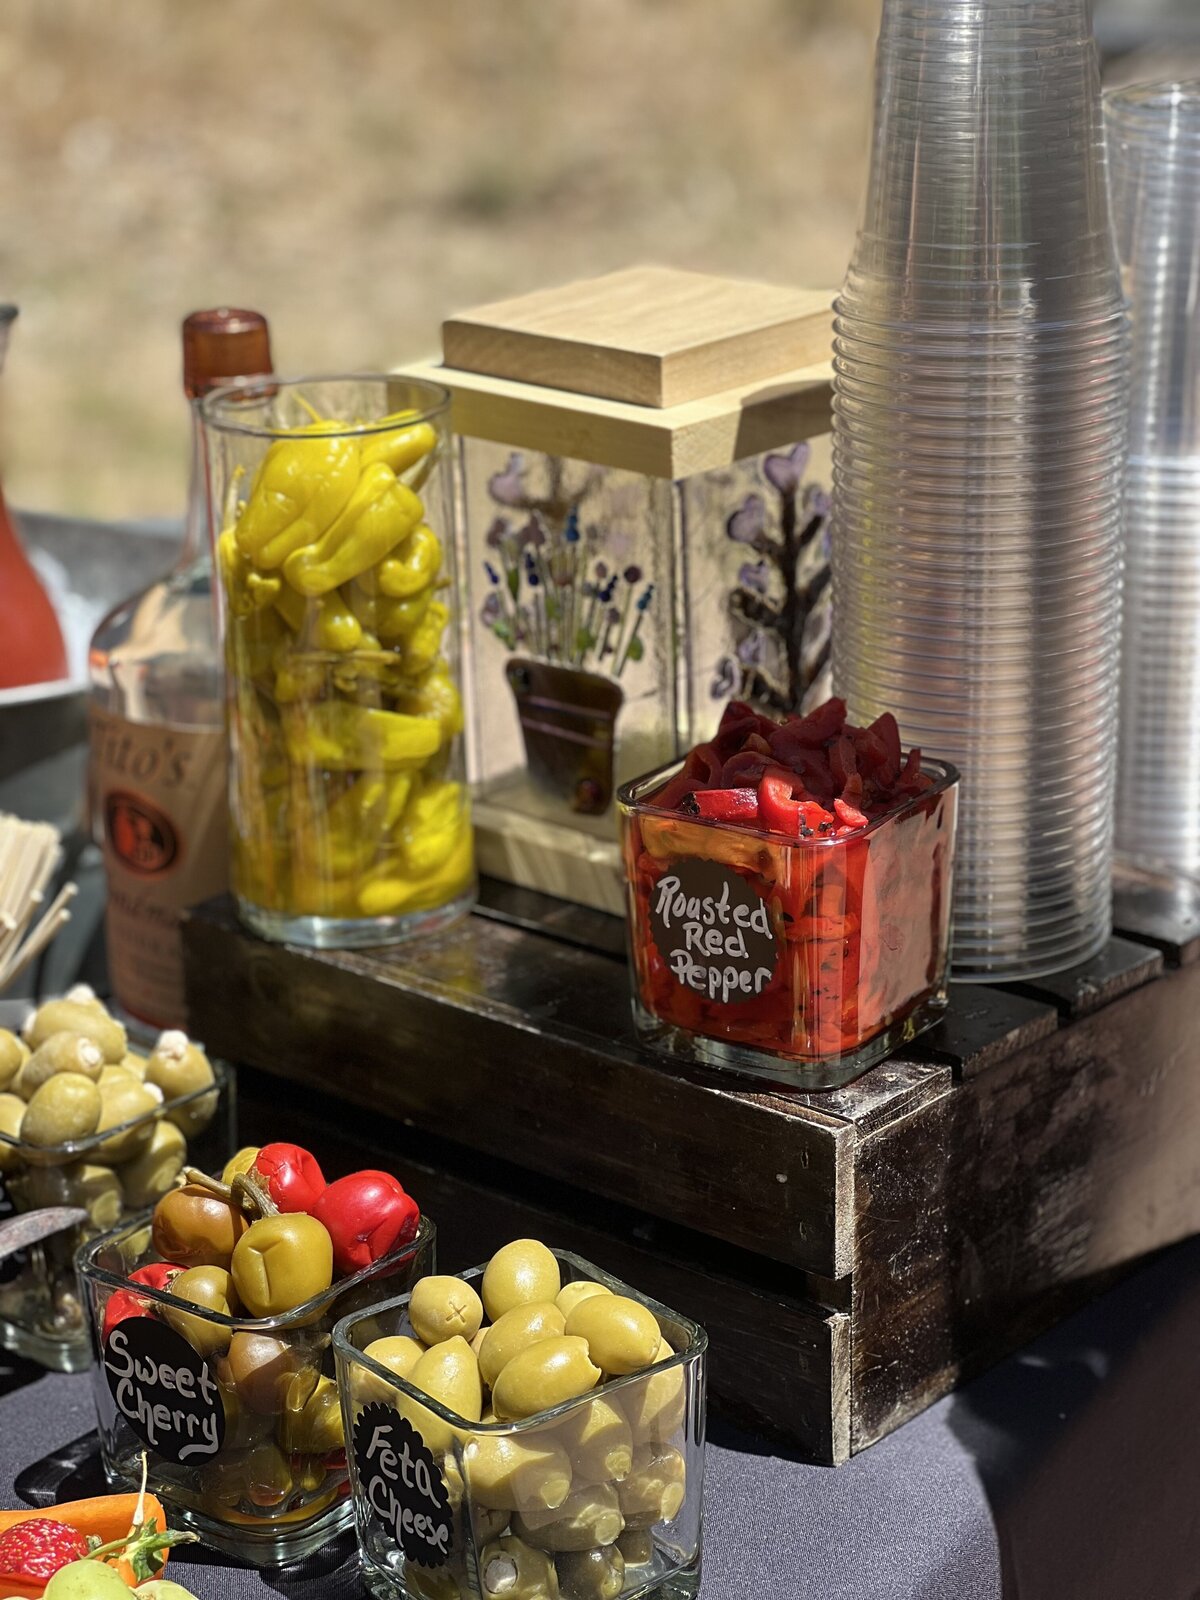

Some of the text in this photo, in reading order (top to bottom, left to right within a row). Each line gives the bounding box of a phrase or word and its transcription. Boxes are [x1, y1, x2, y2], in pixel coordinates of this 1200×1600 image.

[655, 875, 773, 940] Roasted
[682, 921, 749, 959] Red
[669, 949, 772, 1003] Pepper
[104, 1329, 217, 1405] Sweet
[116, 1377, 219, 1460] Cherry
[366, 1425, 442, 1509] Feta
[368, 1475, 449, 1554] Cheese
